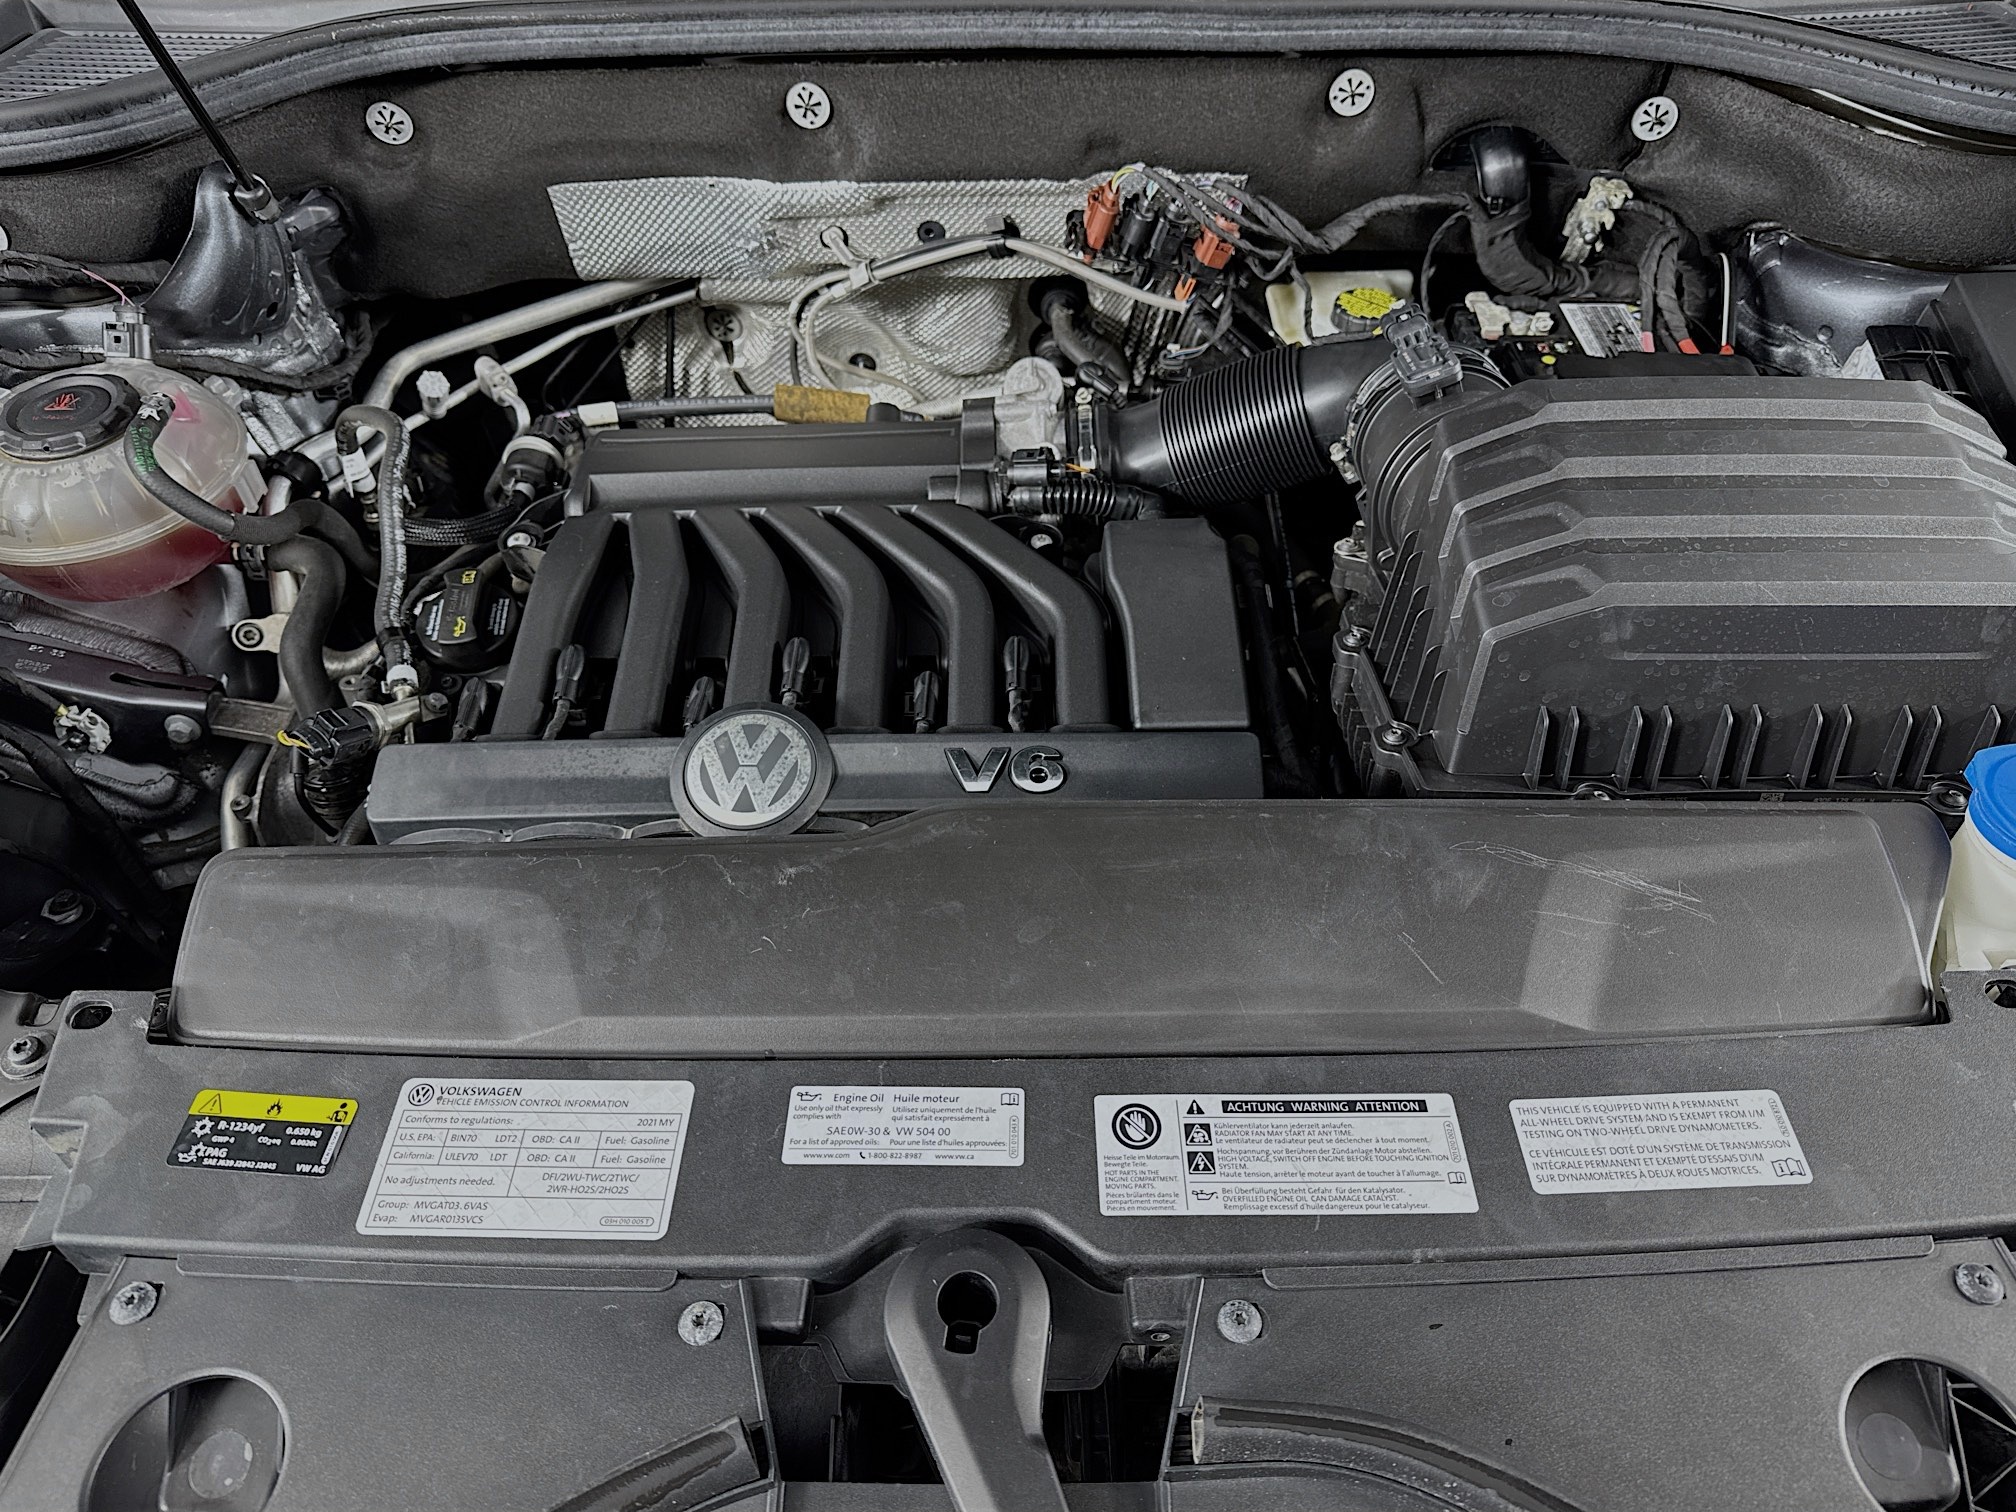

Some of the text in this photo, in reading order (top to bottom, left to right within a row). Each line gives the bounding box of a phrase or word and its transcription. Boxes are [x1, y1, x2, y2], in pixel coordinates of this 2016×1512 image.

[944, 746, 1064, 794] V6
[440, 1086, 522, 1096] VOLKSWAGEN
[436, 1097, 629, 1108] VEHICLE EMISSION CONTROL INFORMATION
[833, 1093, 884, 1103] Engine Oil
[893, 1094, 960, 1103] Huile moteur
[809, 1104, 824, 1113] only
[850, 1105, 883, 1114] expressly
[919, 1106, 963, 1115] uniquement
[1227, 1101, 1419, 1112] ACHTUNG WARNING ATTENTION
[1515, 1098, 1739, 1115] THIS VEHICLE IS EQUIPPED WITH A PERMANENT
[405, 1115, 514, 1125] Conforms to regulations:
[792, 1112, 824, 1121] complies
[891, 1114, 903, 1122] qui
[1520, 1117, 1574, 1127] ALL-WHEEL
[1575, 1115, 1605, 1125] DRIVE
[1606, 1114, 1643, 1124] SYSTEM
[1645, 1113, 1667, 1122] AND
[1668, 1112, 1678, 1121] IS
[1679, 1111, 1716, 1120] EXEMPT
[1718, 1110, 1747, 1119] FROM
[217, 1120, 266, 1134] R-1234yf
[636, 1118, 675, 1126] 2021 MY
[285, 1126, 322, 1138] 0.650 kg
[882, 1126, 890, 1135] &
[896, 1127, 914, 1135] VW
[916, 1127, 935, 1136] 504
[937, 1127, 951, 1136] 00
[1522, 1121, 1762, 1139] TESTING ON TWO-WHEEL DRIVE DYNAMOMETERS.
[417, 1133, 435, 1141] EPA:
[450, 1134, 517, 1143] BIN70 LDT2
[531, 1135, 555, 1143] OBD:
[559, 1135, 572, 1144] CA
[604, 1136, 670, 1145] Fuel: Gasoline
[921, 1138, 936, 1146] liste
[829, 1138, 864, 1147] approved
[204, 1146, 228, 1157] PAG
[1528, 1149, 1542, 1158] CE
[1541, 1147, 1590, 1157] VÉHICULE
[1590, 1146, 1606, 1156] EST
[1608, 1143, 1635, 1155] DOTÉ
[1636, 1144, 1662, 1154] D'UN
[1705, 1142, 1719, 1151] DE
[1718, 1139, 1791, 1150] TRANSMISSION
[393, 1151, 434, 1159] California:
[444, 1152, 508, 1161] ULEV70 LDT
[526, 1153, 576, 1162] OBD: CA II
[600, 1154, 666, 1164] Fuel: Gasoline
[202, 1157, 218, 1165] SAE
[1532, 1159, 1584, 1170] INTÉGRALE
[1584, 1158, 1641, 1168] PERMANENT
[1642, 1157, 1654, 1166] ET
[1655, 1153, 1697, 1166] EXEMPTÉ
[1697, 1153, 1738, 1164] D'ESSAIS
[296, 1163, 326, 1174] VW AG
[1535, 1173, 1556, 1183] SUR
[1638, 1168, 1647, 1179] À
[1647, 1169, 1676, 1178] DEUX
[1676, 1167, 1710, 1177] ROUES
[1710, 1165, 1761, 1175] MOTRICES.
[384, 1175, 495, 1186] No adjustments needed.
[1327, 1194, 1361, 1202] DAMAGE
[1362, 1194, 1398, 1202] CATALYST.
[377, 1199, 409, 1211] Group:
[372, 1213, 397, 1224] Evap:
